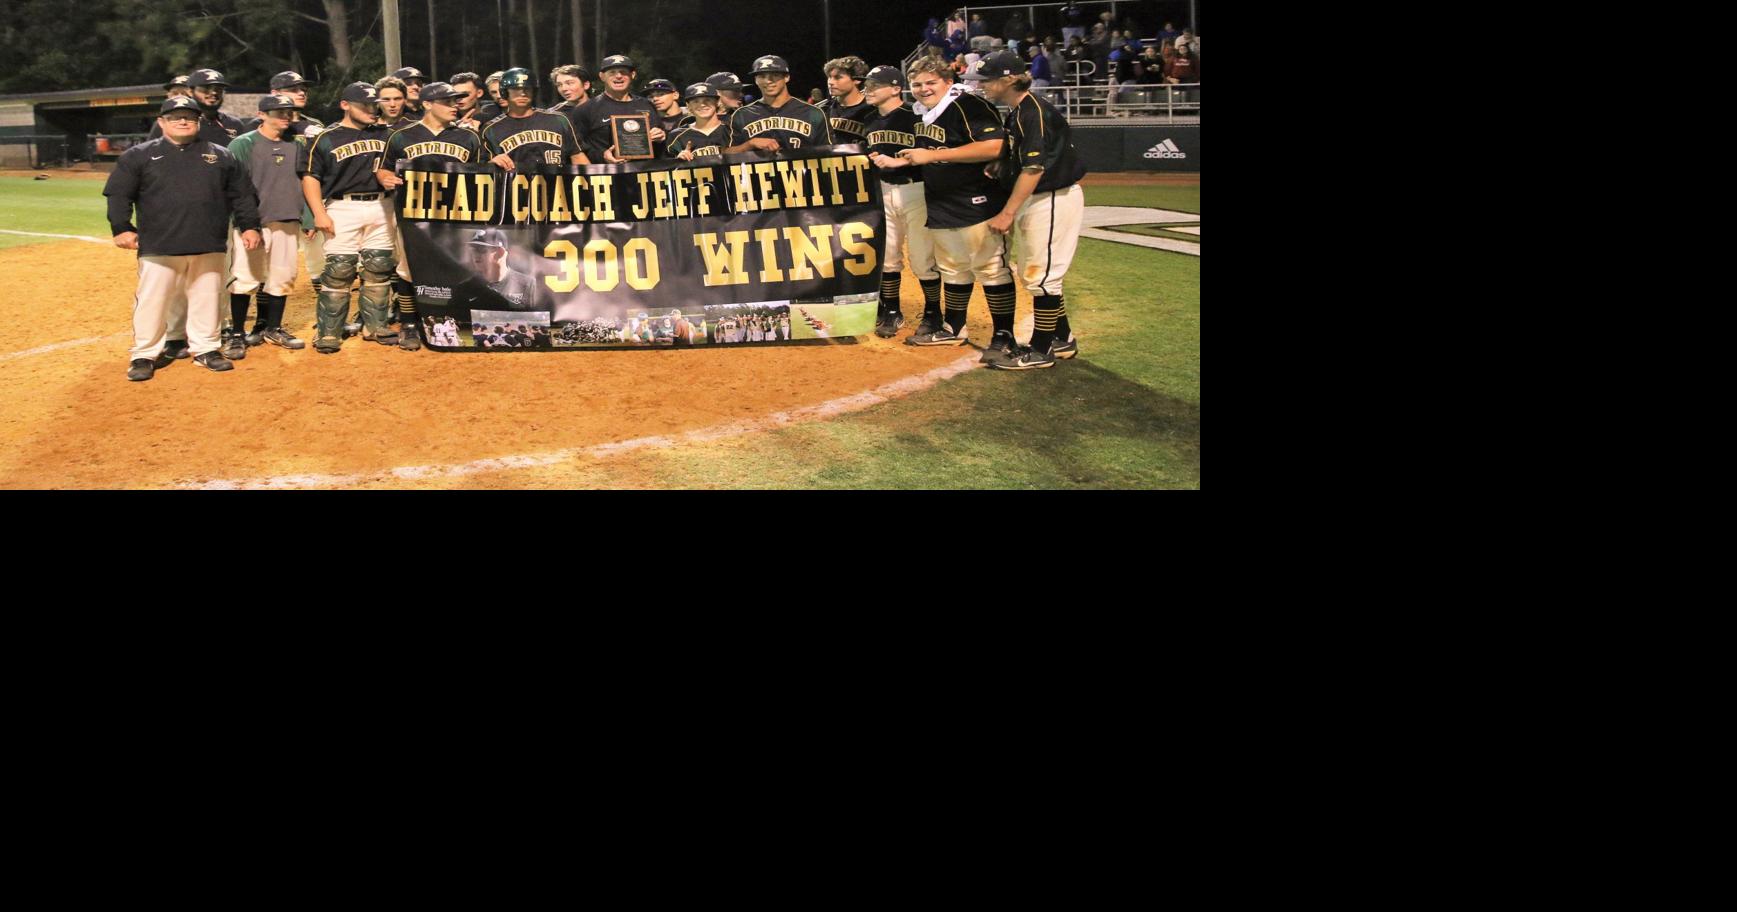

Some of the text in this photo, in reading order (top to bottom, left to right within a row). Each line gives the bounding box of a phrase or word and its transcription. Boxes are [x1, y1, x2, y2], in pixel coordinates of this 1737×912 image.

[744, 116, 812, 138] PATRIOTS
[500, 129, 562, 154] PATRIOTS
[789, 137, 801, 149] 7
[867, 130, 915, 147] TRIOTS
[330, 139, 386, 162] PATRIO
[404, 141, 470, 163] PATRIOTS
[545, 150, 561, 165] 15
[1143, 150, 1186, 159] adidas
[402, 154, 870, 222] HEAD COACH JEFF HEWITT
[544, 221, 877, 293] 300 WINS
